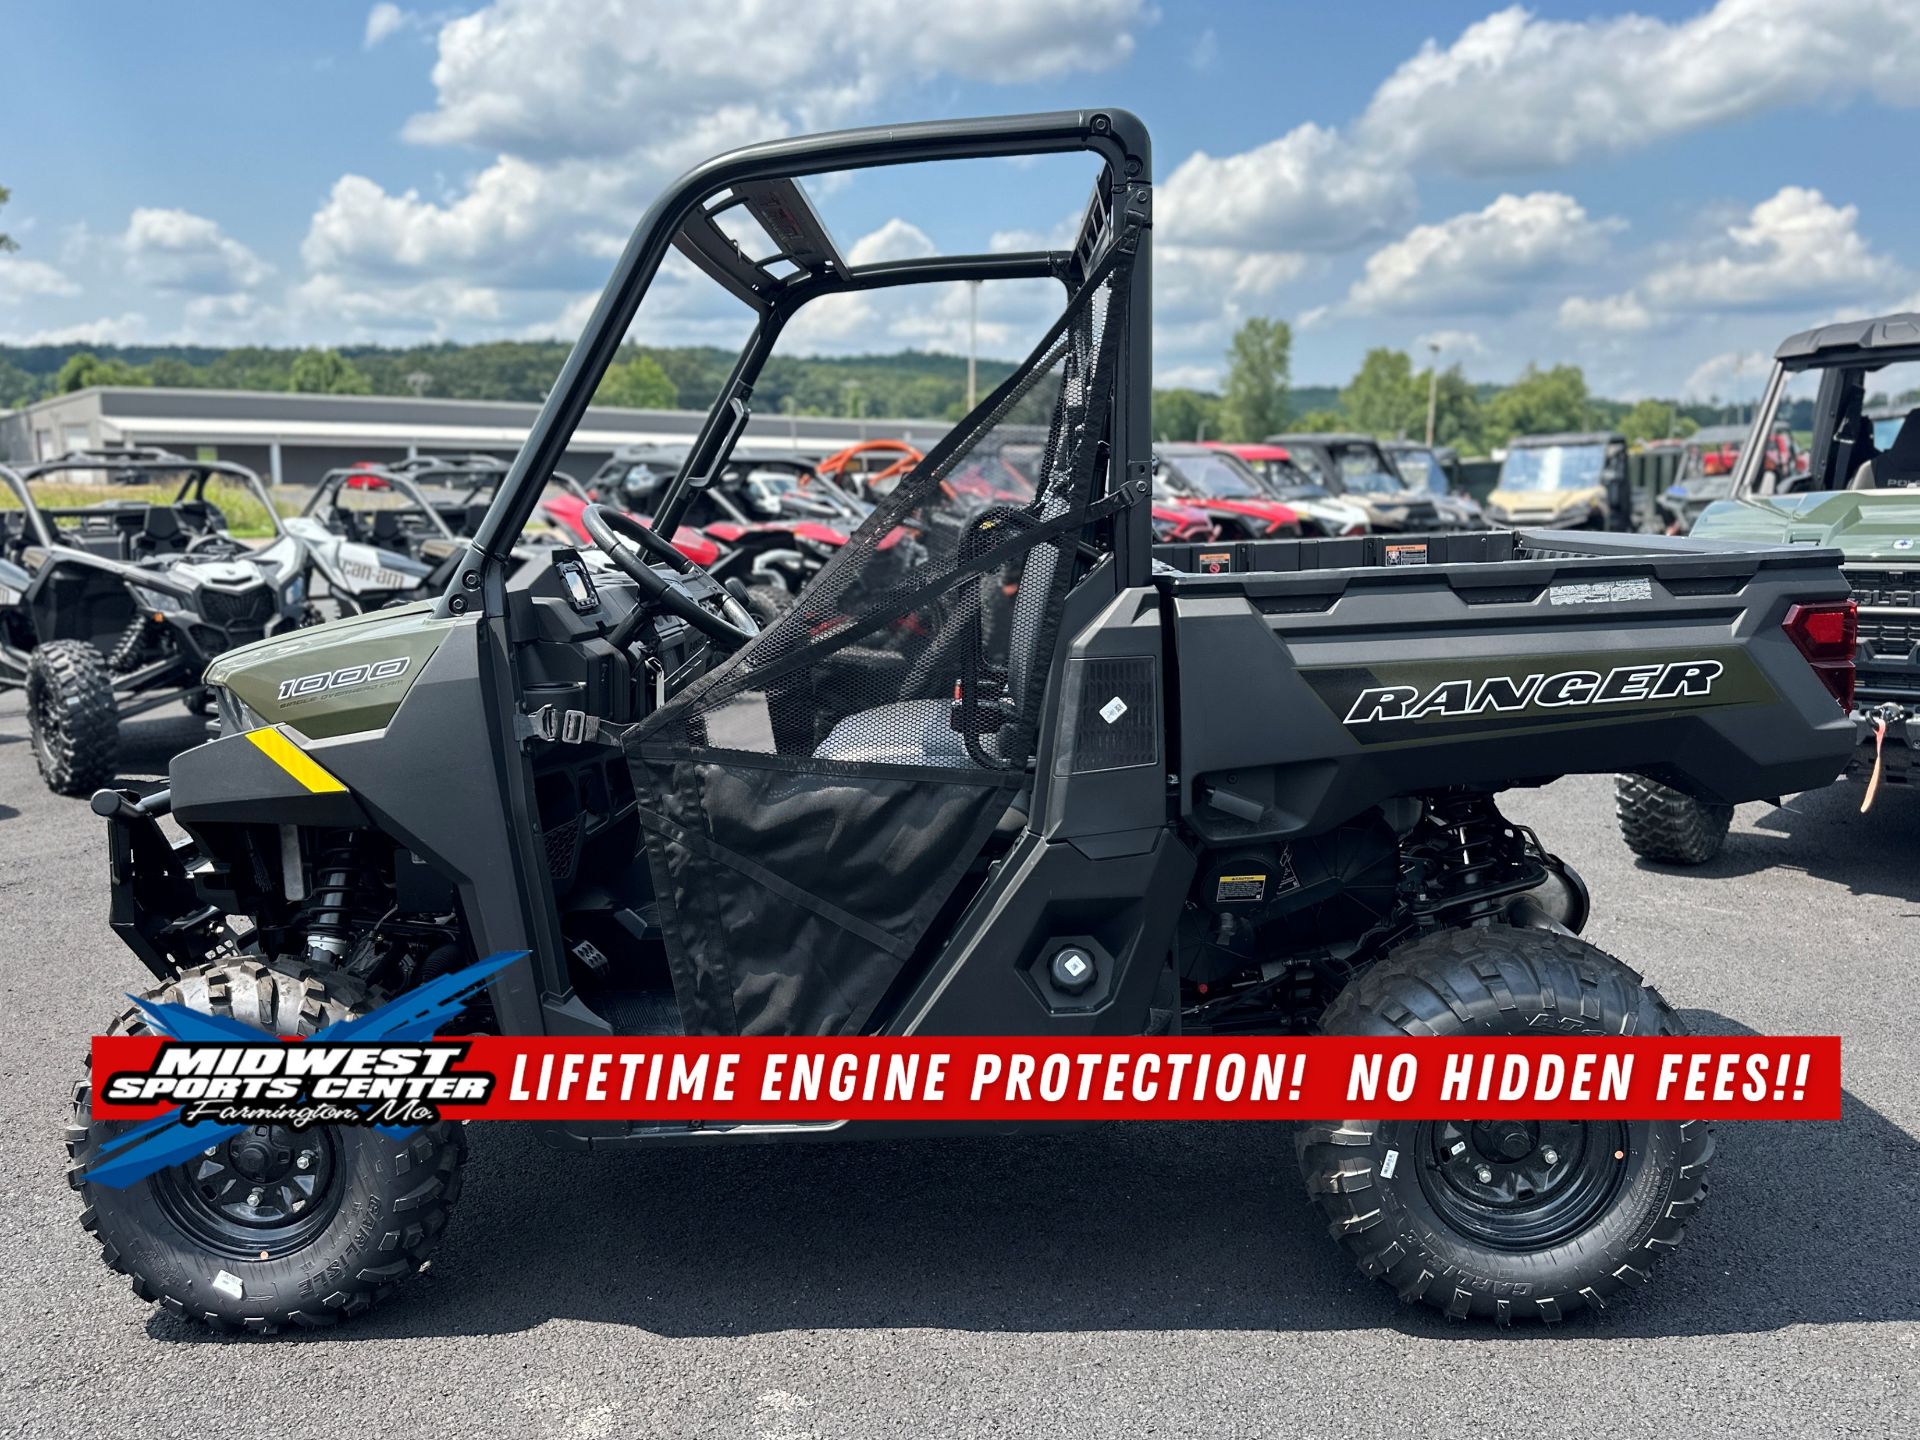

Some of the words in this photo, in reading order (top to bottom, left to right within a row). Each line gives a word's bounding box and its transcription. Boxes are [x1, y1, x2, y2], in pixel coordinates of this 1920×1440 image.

[278, 656, 410, 700] 1000
[279, 696, 317, 709] SINGLE
[320, 684, 377, 701] OVERHEAD
[1342, 659, 1723, 724] RANGER
[297, 1193, 381, 1297] CARLISLE
